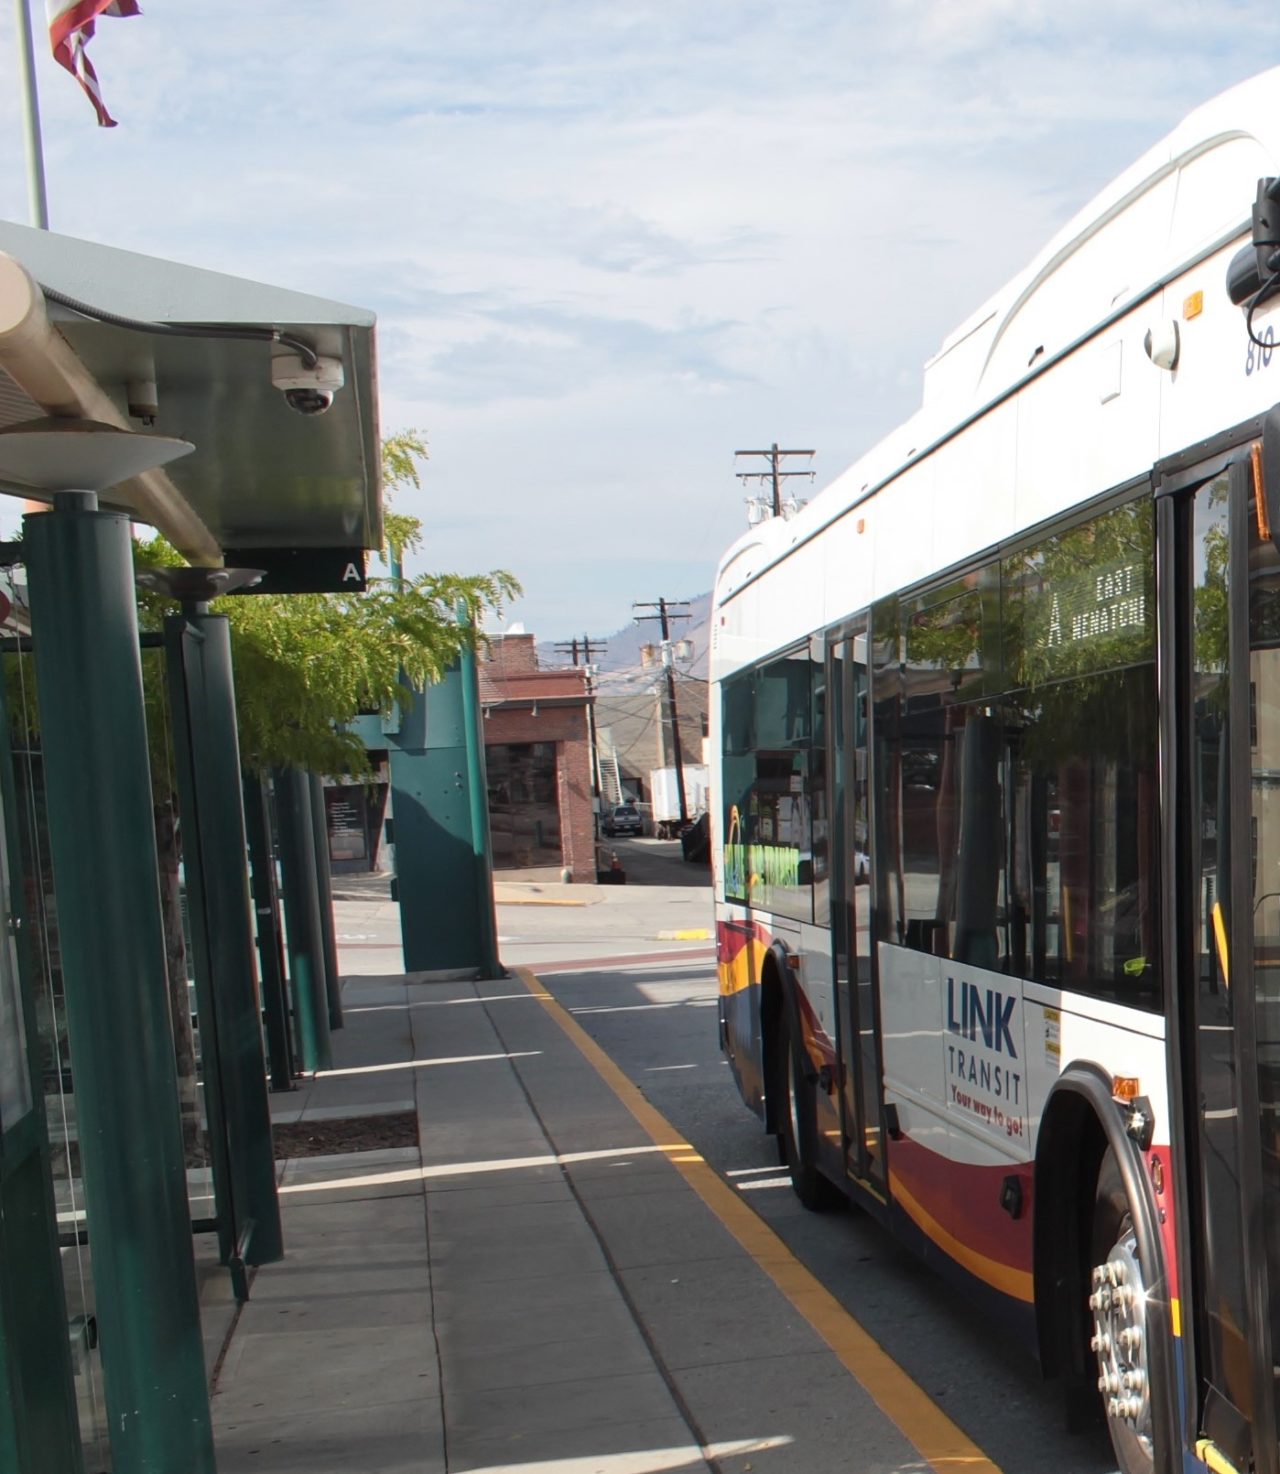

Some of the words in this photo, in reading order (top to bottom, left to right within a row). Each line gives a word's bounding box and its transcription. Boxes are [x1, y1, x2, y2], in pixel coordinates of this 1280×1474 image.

[1246, 326, 1274, 376] 810
[342, 562, 361, 582] A
[1097, 566, 1133, 601] EAST
[1048, 592, 1062, 648] A
[948, 978, 1018, 1060] LINK
[948, 1046, 1021, 1105] TRANSIT
[951, 1084, 971, 1109] Your
[973, 1100, 992, 1124] way
[994, 1106, 1004, 1126] to
[1006, 1115, 1023, 1137] go!
